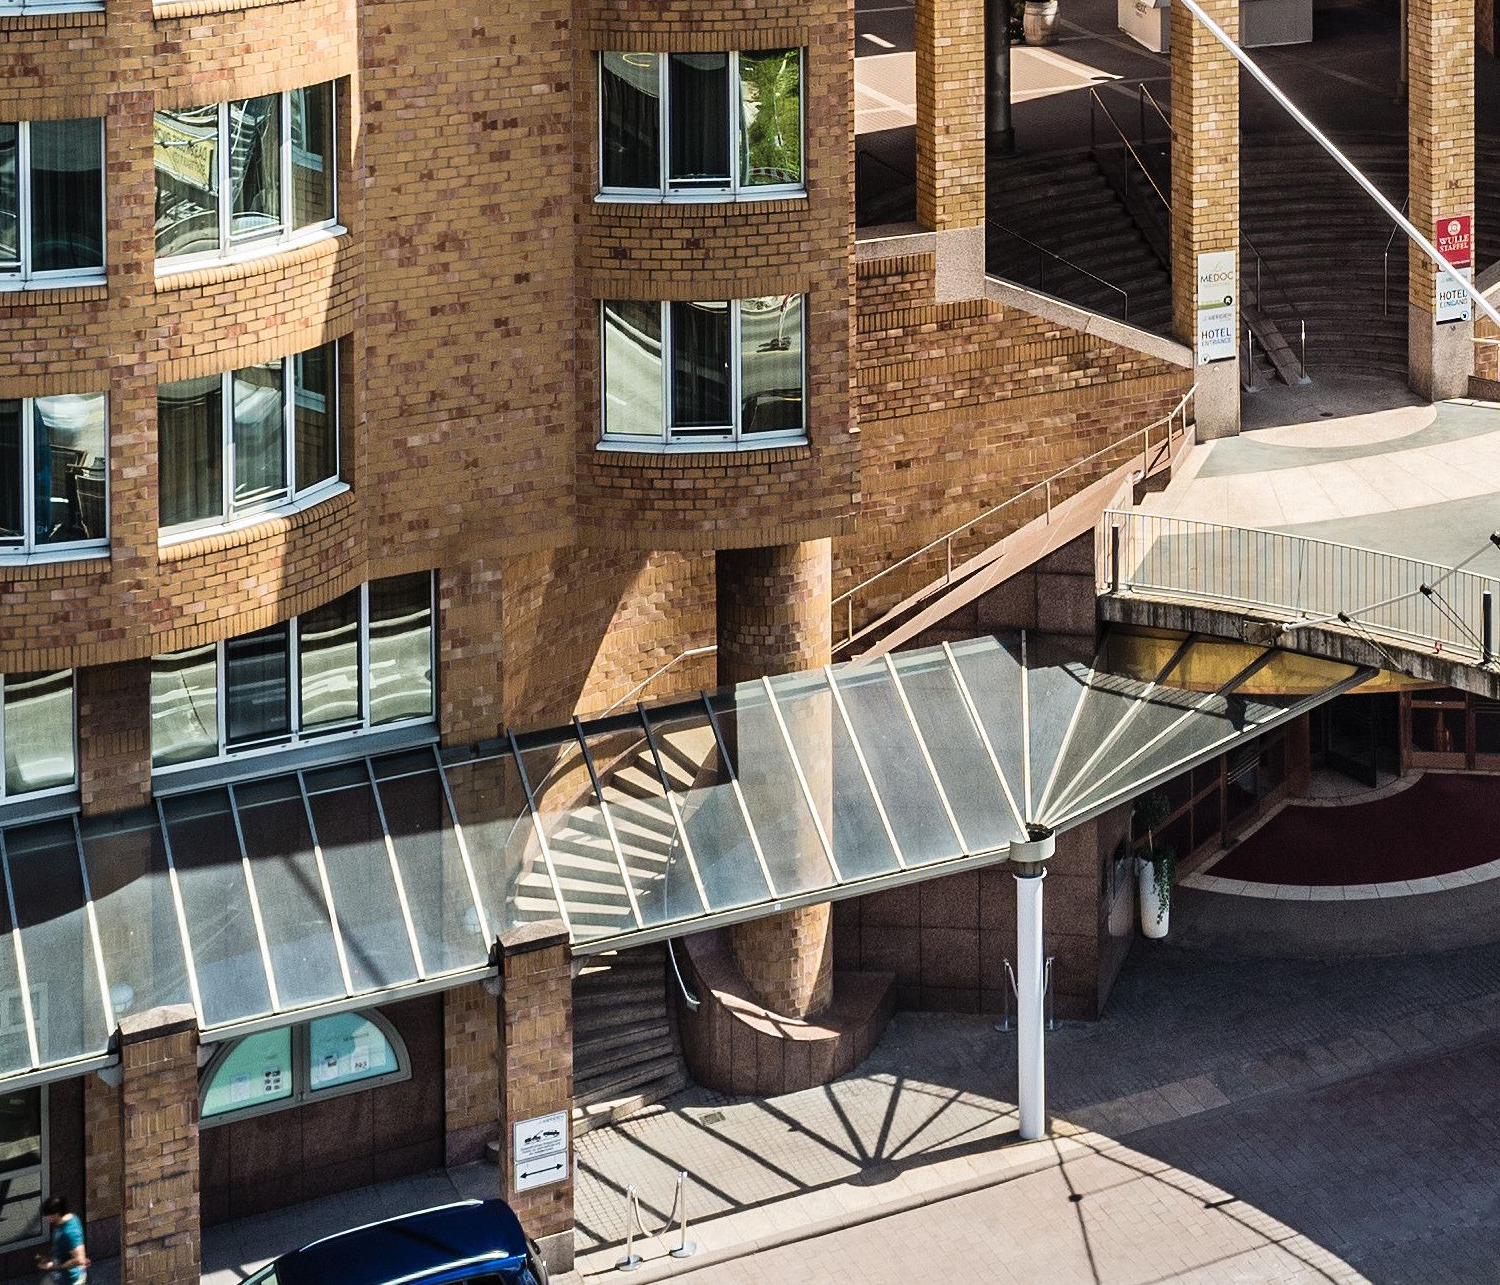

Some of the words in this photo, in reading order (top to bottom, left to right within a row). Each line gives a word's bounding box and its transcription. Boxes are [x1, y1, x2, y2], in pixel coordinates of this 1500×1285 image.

[1439, 234, 1469, 245] WULLE
[1200, 271, 1234, 283] MEDOC
[1439, 289, 1468, 300] HOTEL
[1201, 327, 1231, 339] HOTEL
